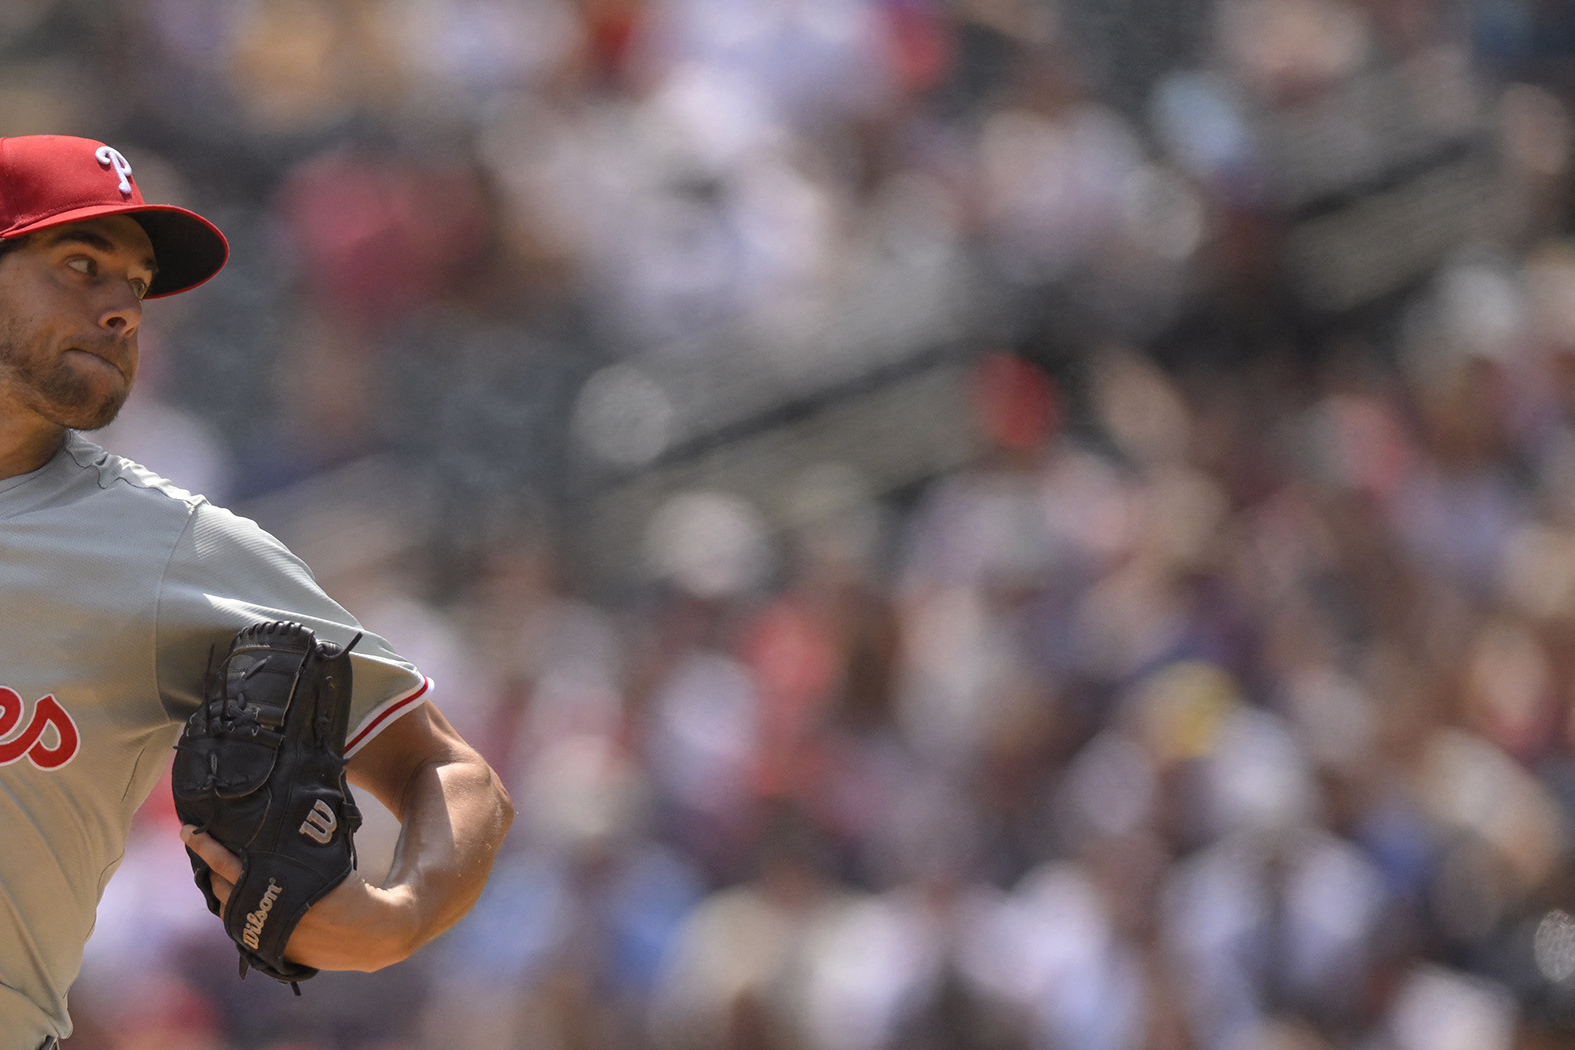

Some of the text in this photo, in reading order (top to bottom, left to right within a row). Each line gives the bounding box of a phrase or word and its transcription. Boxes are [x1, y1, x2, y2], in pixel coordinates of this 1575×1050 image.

[95, 145, 133, 194] P
[298, 798, 338, 844] W
[243, 883, 283, 950] Wilson
